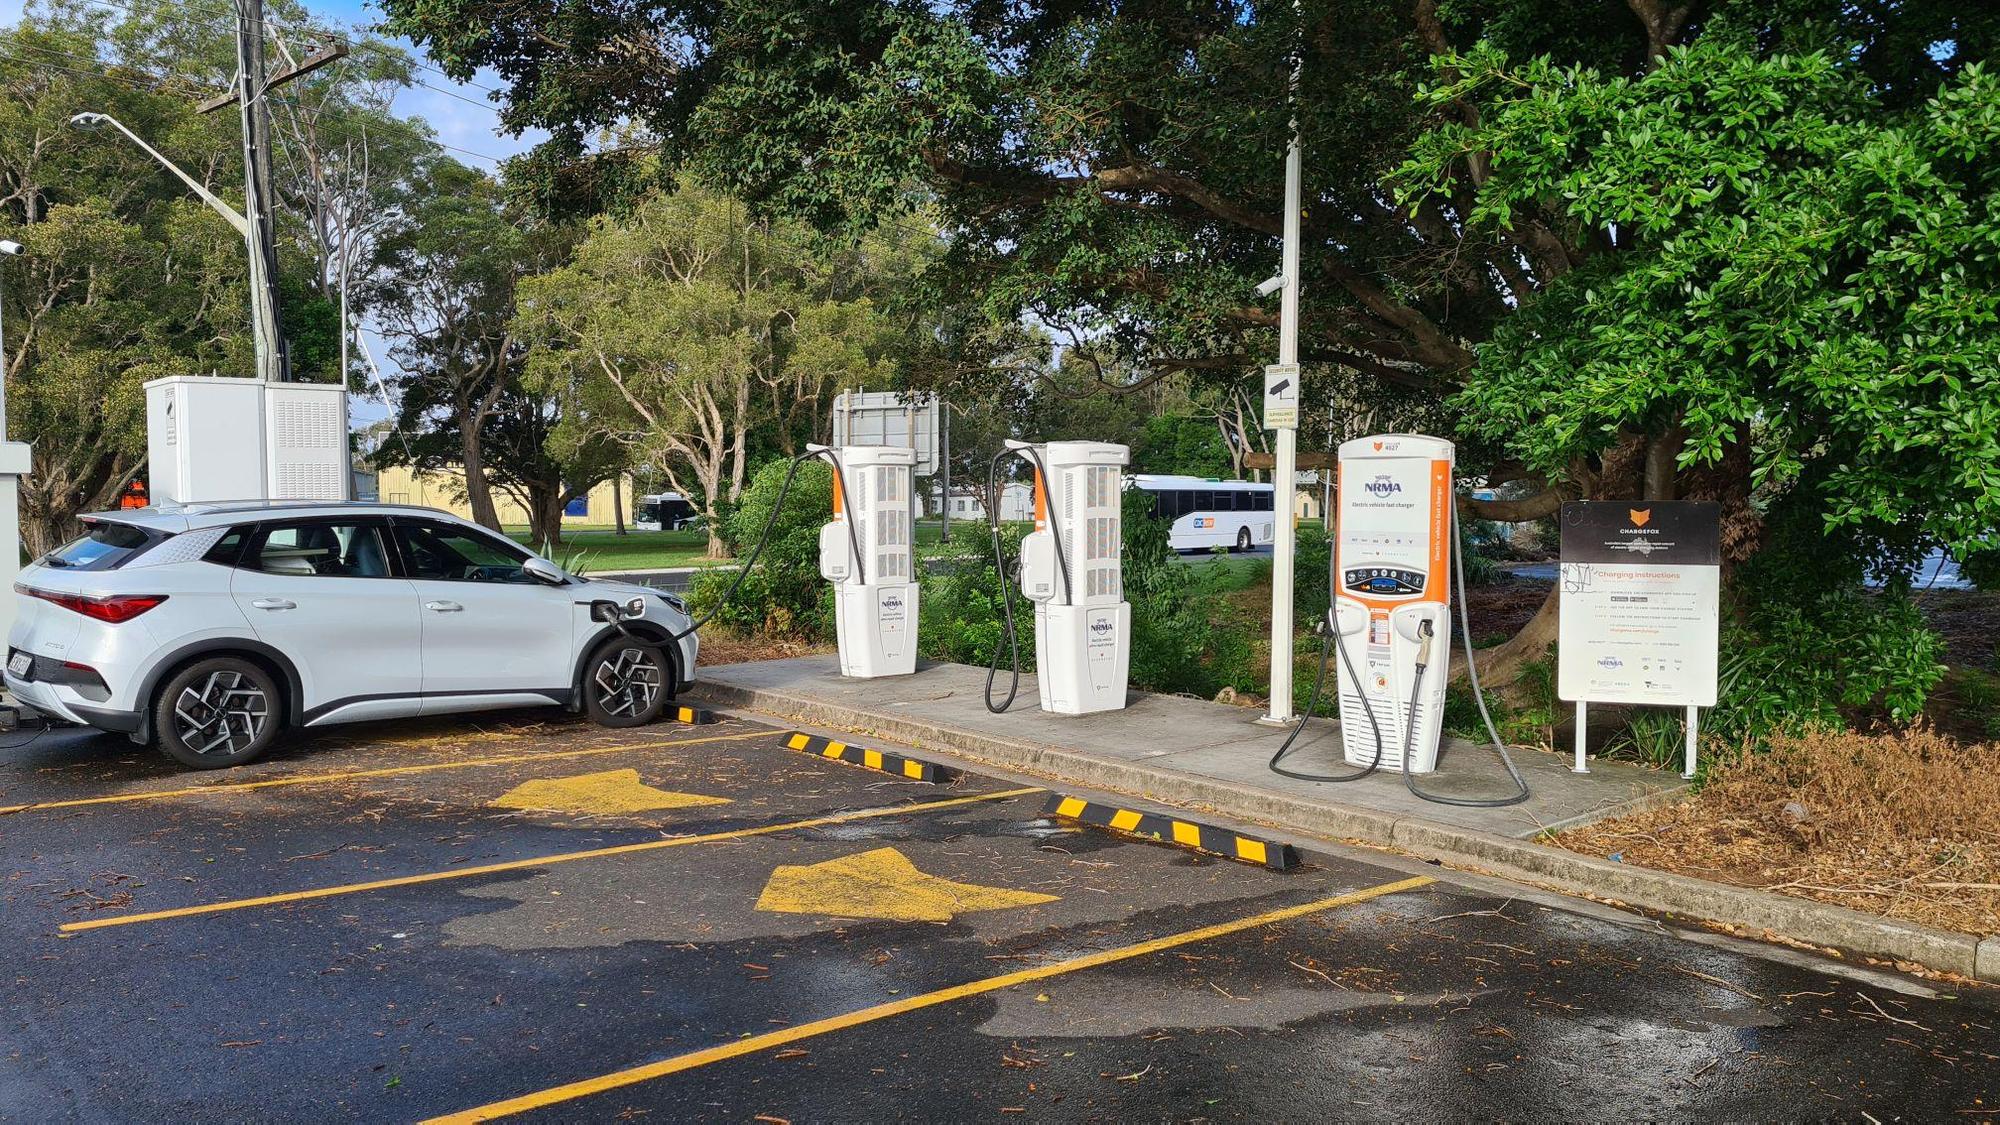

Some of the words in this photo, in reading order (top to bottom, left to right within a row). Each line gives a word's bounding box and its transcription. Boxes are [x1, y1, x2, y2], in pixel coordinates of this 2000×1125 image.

[1364, 482, 1402, 493] NRMA
[1598, 571, 1634, 579] Charging
[1090, 623, 1113, 632] NRMA
